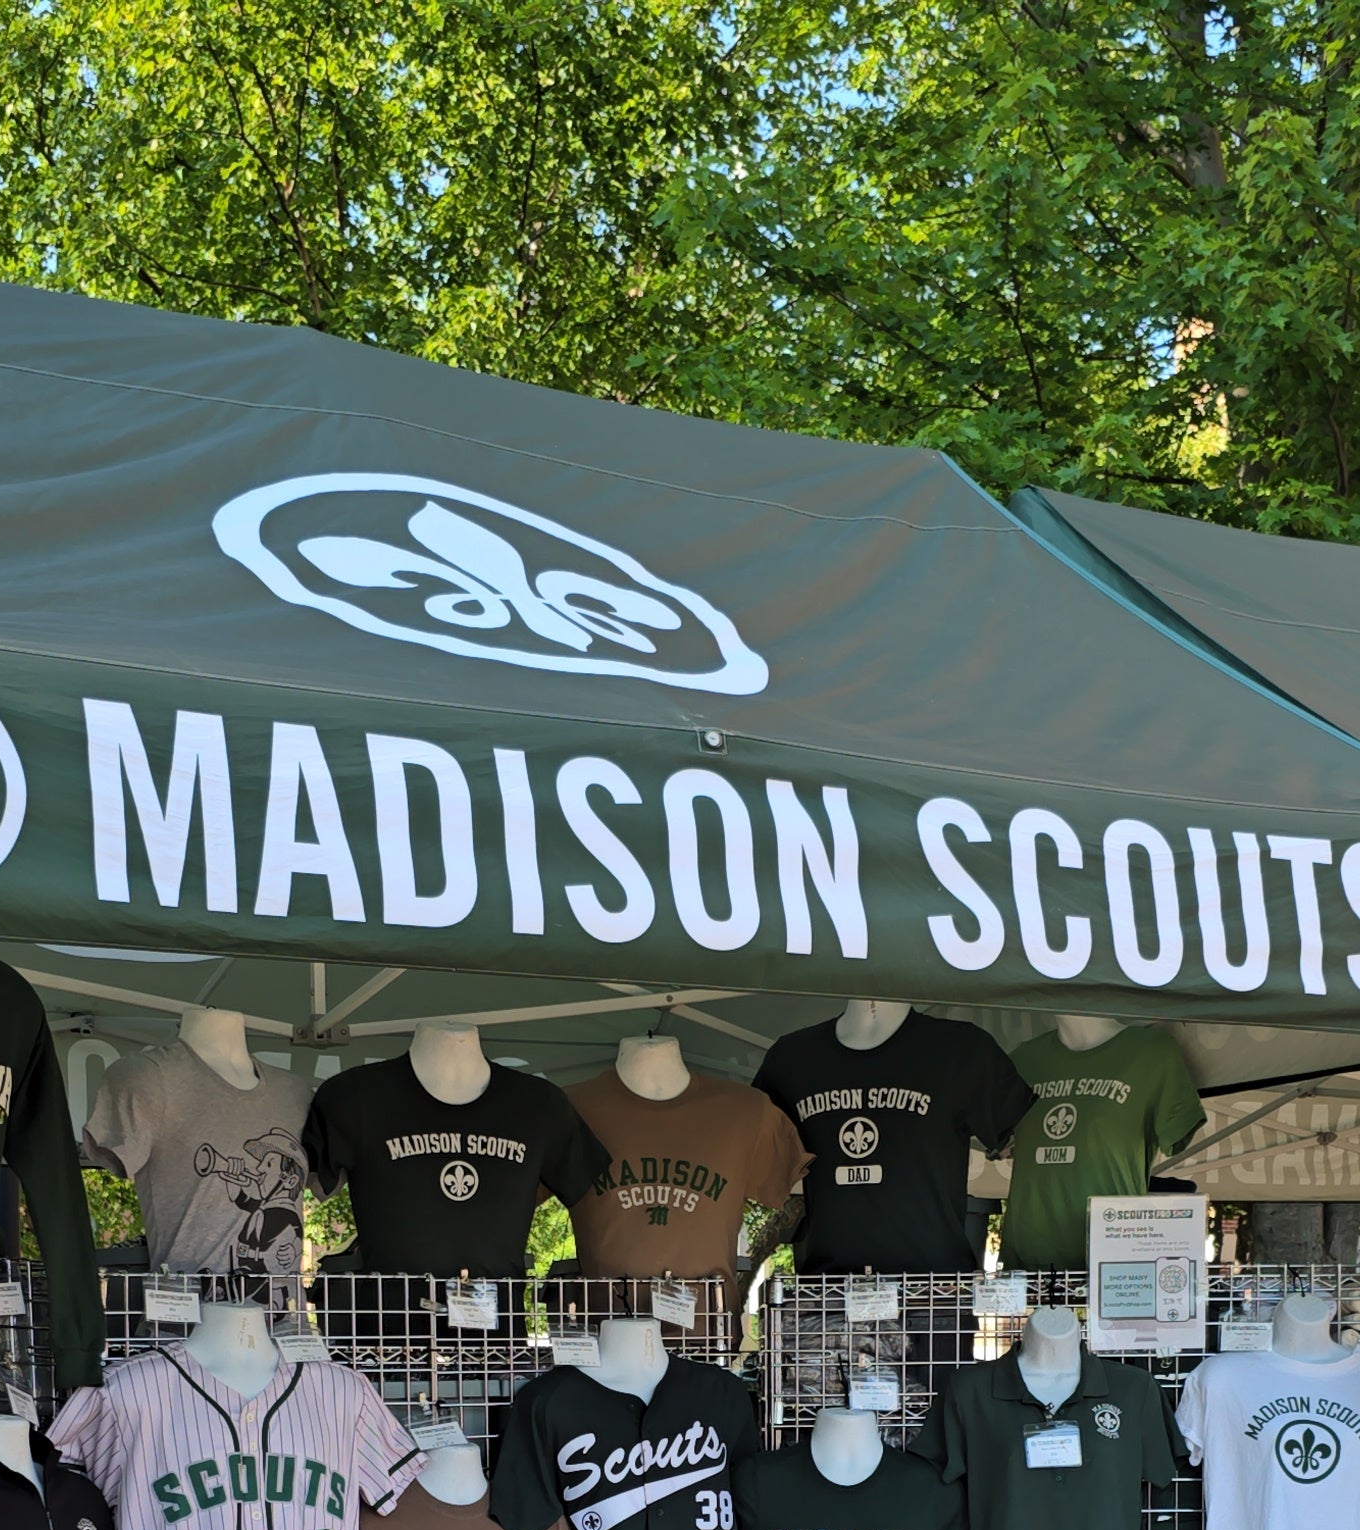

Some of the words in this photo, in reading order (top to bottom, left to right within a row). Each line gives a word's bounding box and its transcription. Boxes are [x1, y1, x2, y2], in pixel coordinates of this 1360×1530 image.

[83, 698, 868, 960] MADISON
[796, 1088, 863, 1122] MADISON
[867, 1088, 931, 1116] SCOUTS
[1030, 1078, 1072, 1100] DISON
[1076, 1078, 1130, 1104] SCOUTS
[385, 1133, 461, 1162] MADISON
[466, 1134, 527, 1164] SCOUTS
[1043, 1148, 1069, 1163] MOM
[593, 1157, 728, 1202] MADISON
[847, 1168, 871, 1183] DAD
[617, 1186, 700, 1213] SCOUTS
[1117, 1210, 1153, 1220] SCOUTS
[1243, 1395, 1310, 1441] MADISON
[556, 1420, 727, 1501] Scouts
[152, 1452, 346, 1525] SCOUTS
[695, 1490, 734, 1530] 38
